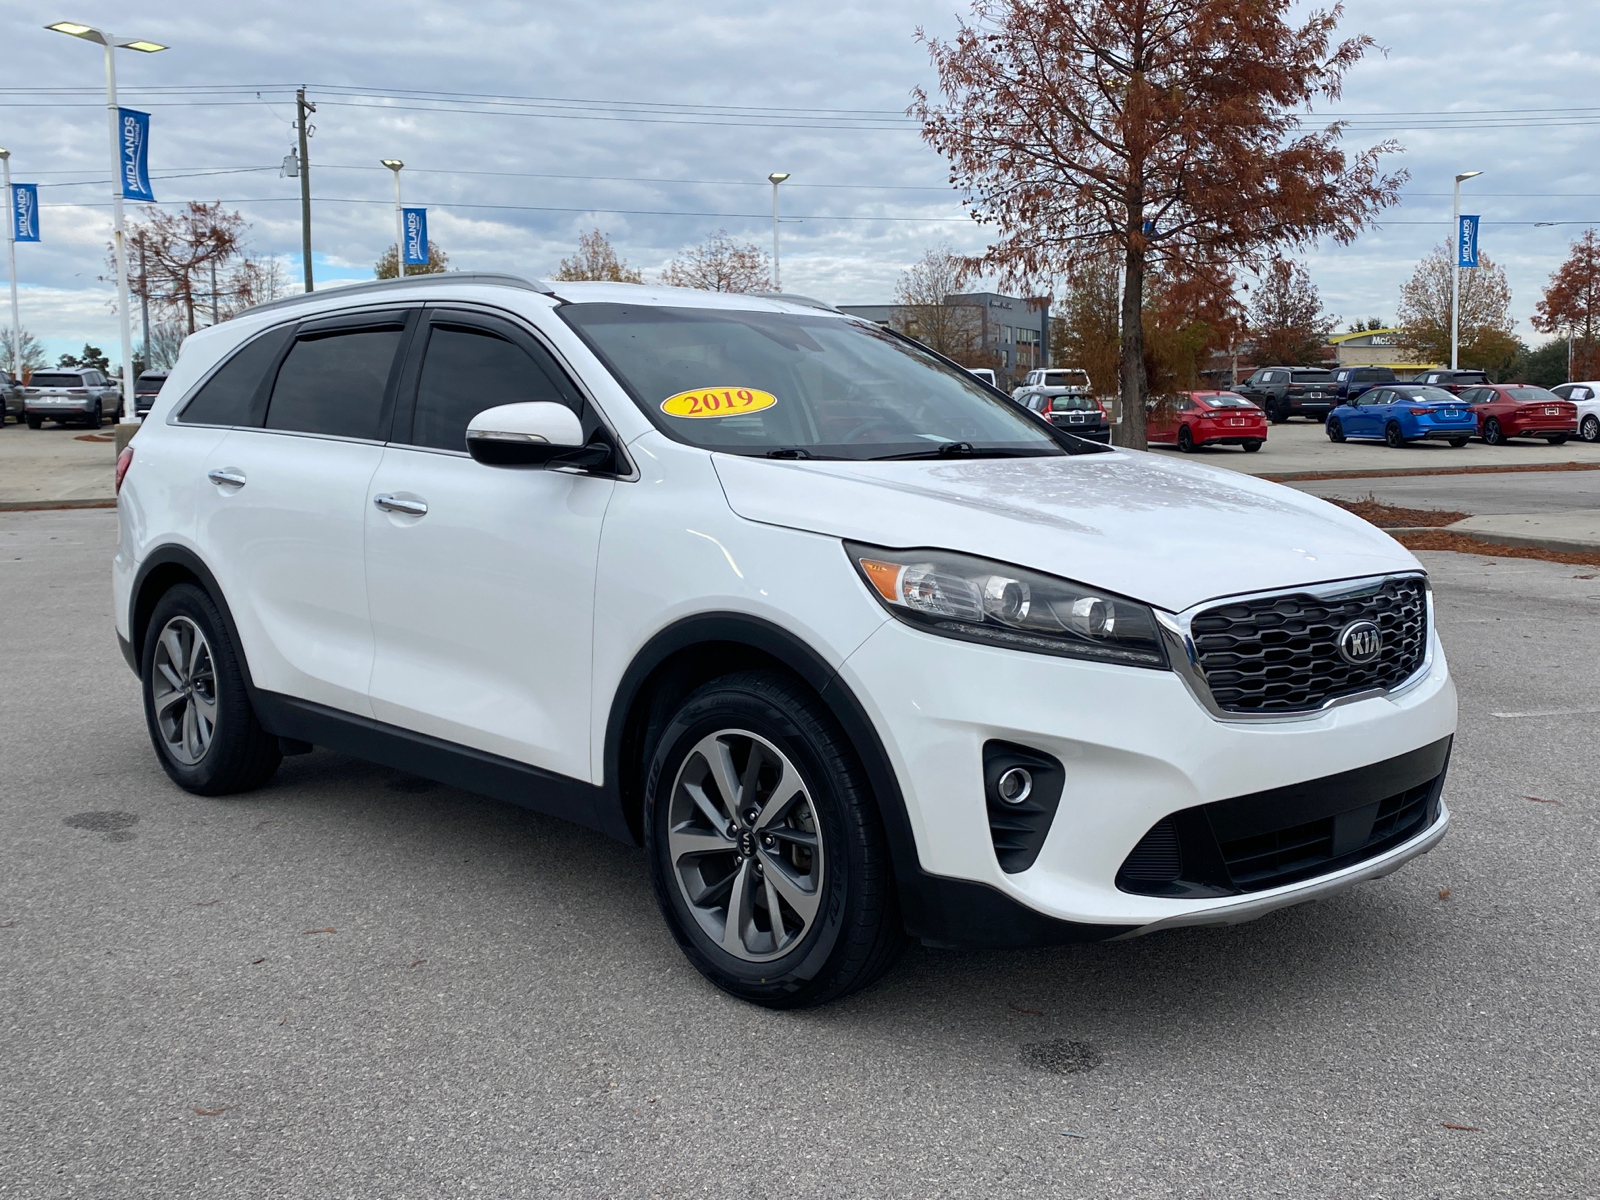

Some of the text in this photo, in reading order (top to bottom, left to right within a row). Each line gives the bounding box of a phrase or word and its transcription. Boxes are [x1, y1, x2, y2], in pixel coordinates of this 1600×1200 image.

[124, 116, 138, 191] MIDLANDS
[17, 188, 28, 236] MIDLANDS
[408, 212, 417, 259] MIDLANDS
[1463, 219, 1471, 262] MIDLANDS
[683, 390, 754, 415] 2019
[1351, 630, 1380, 656] KIA
[743, 832, 751, 855] KIA
